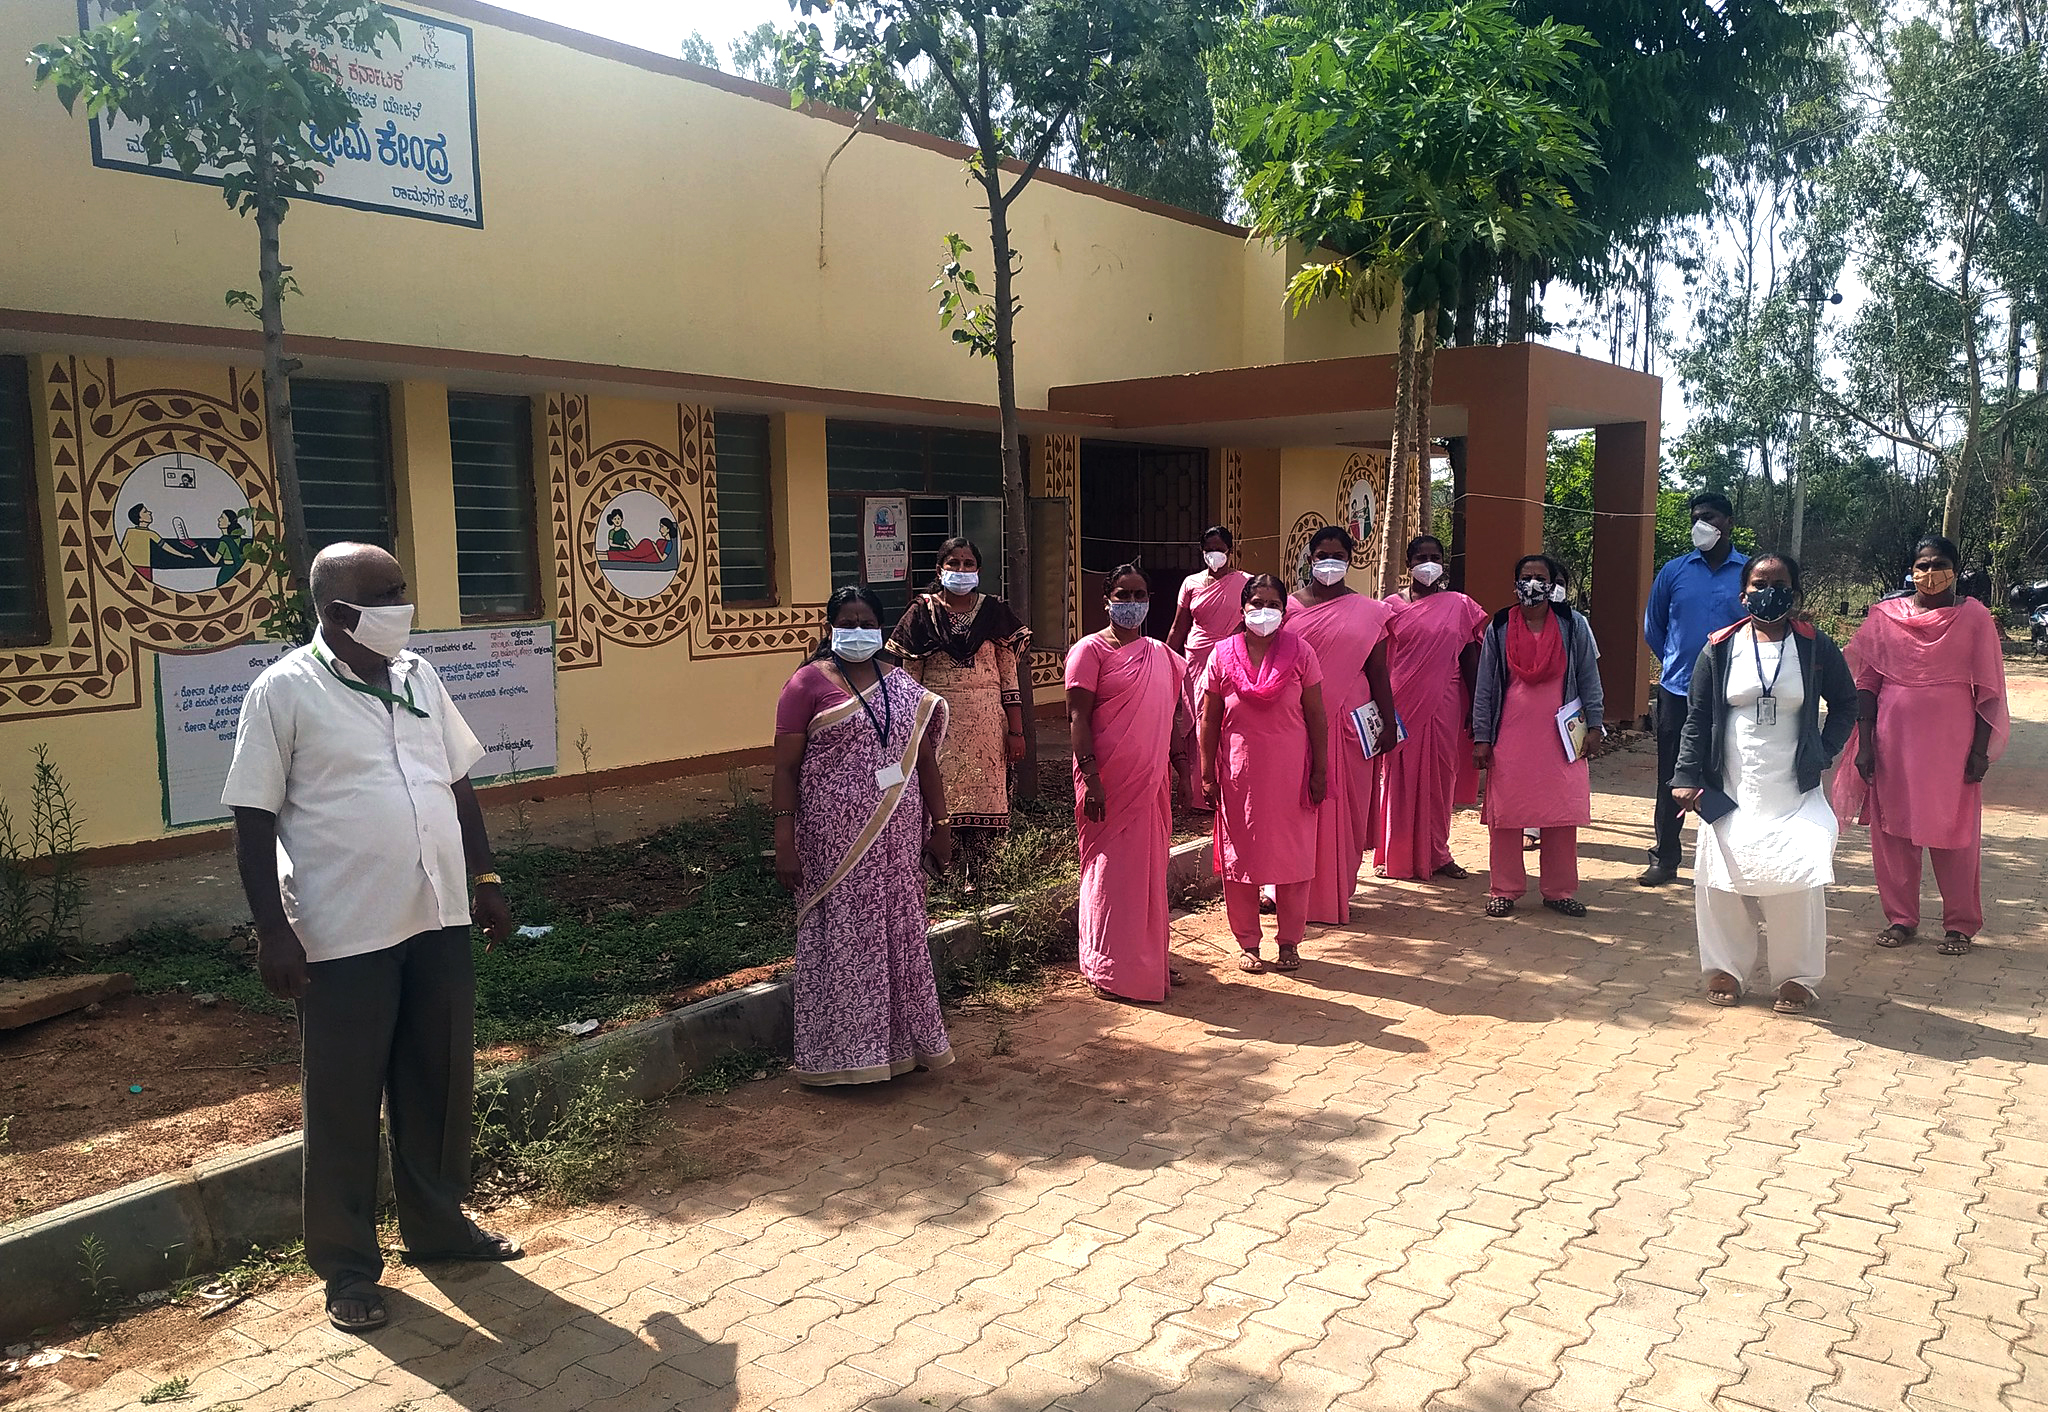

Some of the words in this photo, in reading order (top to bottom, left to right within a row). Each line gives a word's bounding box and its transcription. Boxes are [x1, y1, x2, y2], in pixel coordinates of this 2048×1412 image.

[383, 96, 423, 121] ಯೋಜನೆ
[375, 119, 453, 185] ಕೇಂದ್ರ
[392, 185, 445, 208] ರಾಮನಗರ
